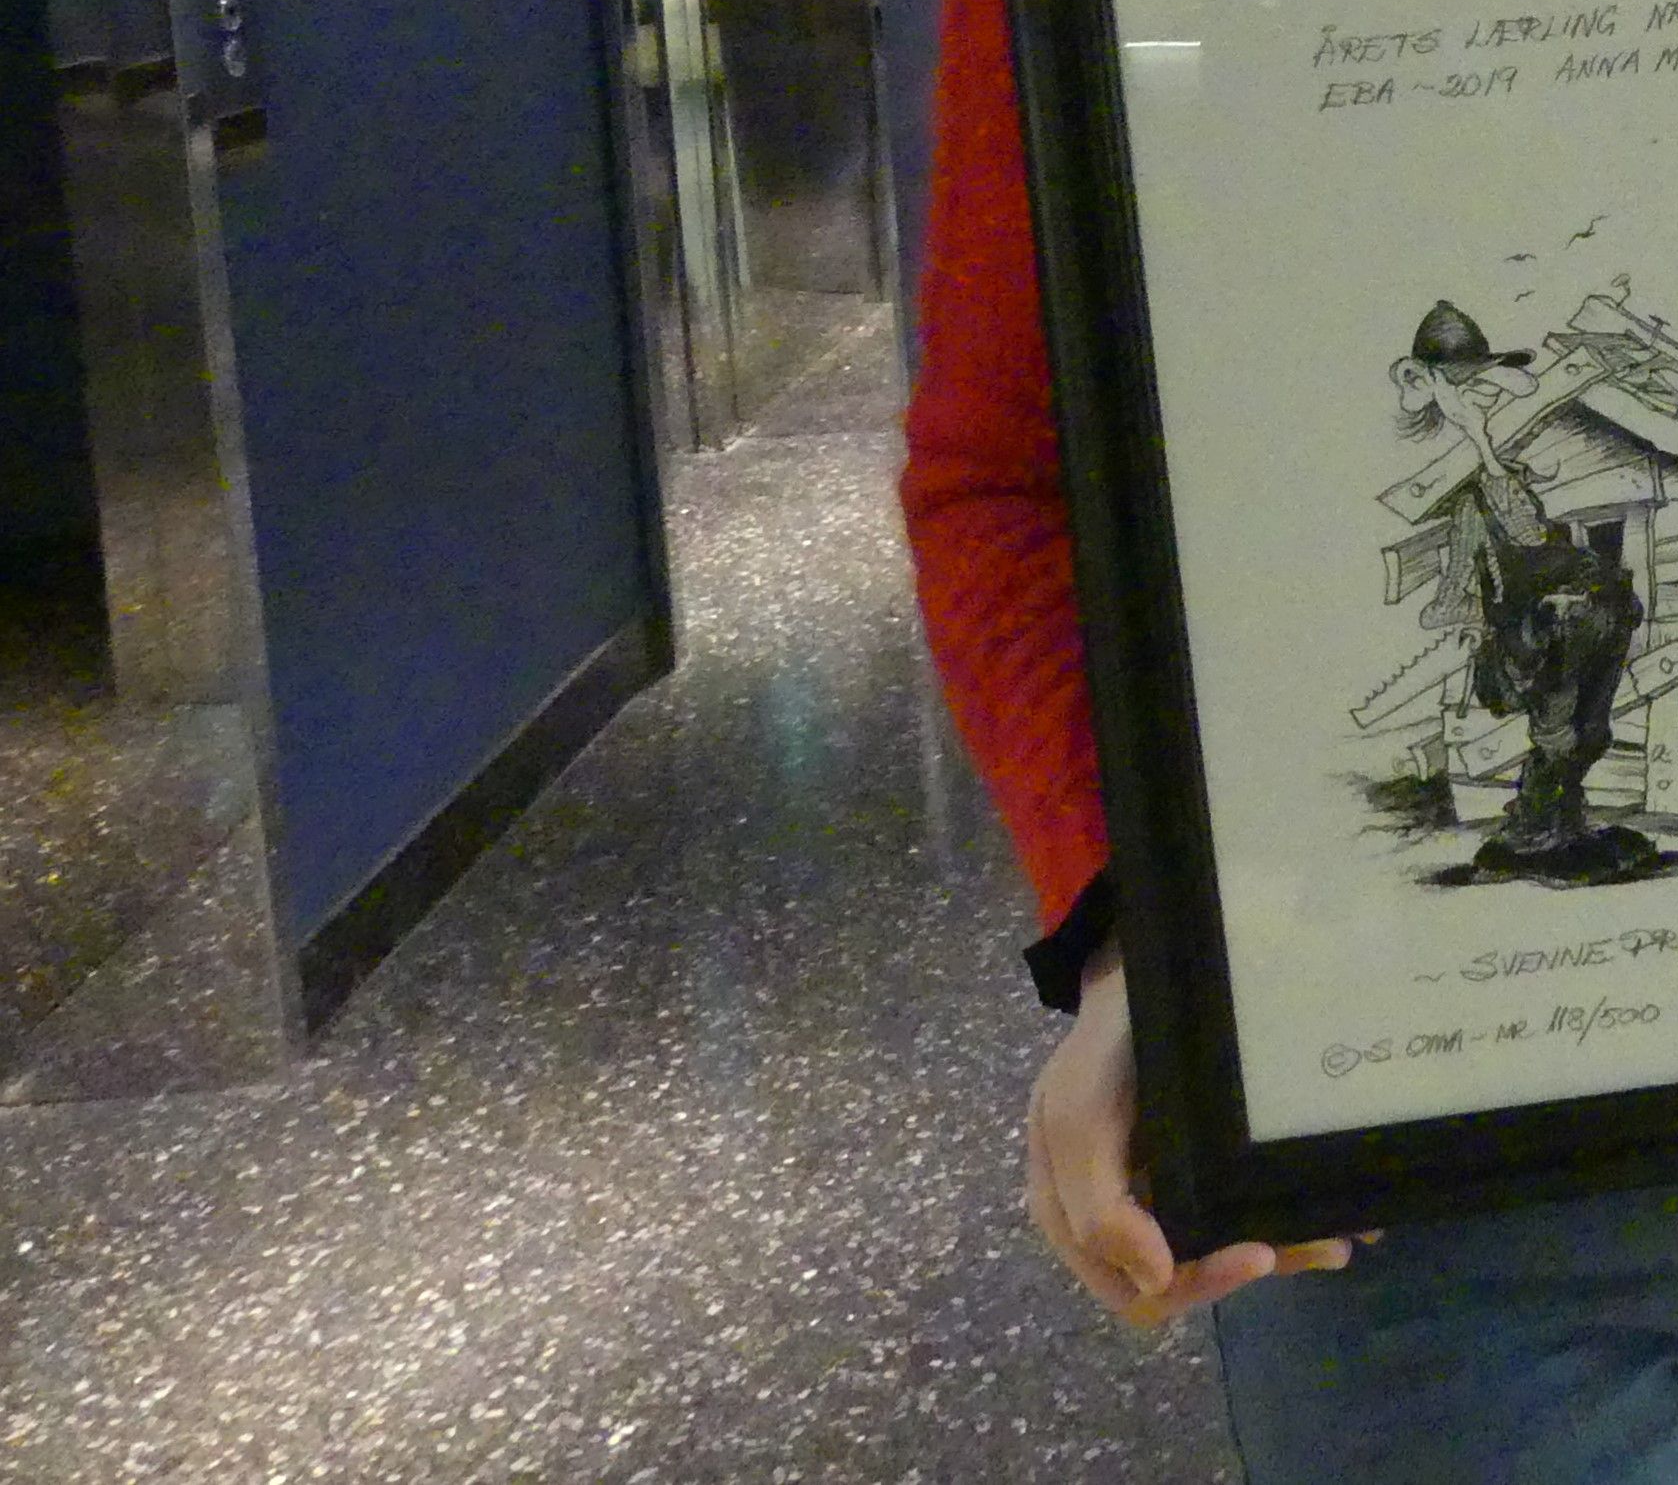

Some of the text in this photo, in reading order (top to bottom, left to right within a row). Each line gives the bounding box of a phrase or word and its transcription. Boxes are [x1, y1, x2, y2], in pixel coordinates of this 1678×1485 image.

[1313, 23, 1442, 68] ÅRETS
[1464, 6, 1618, 50] LÆRLING
[1319, 78, 1394, 112] EBA
[1555, 48, 1640, 83] ANNA
